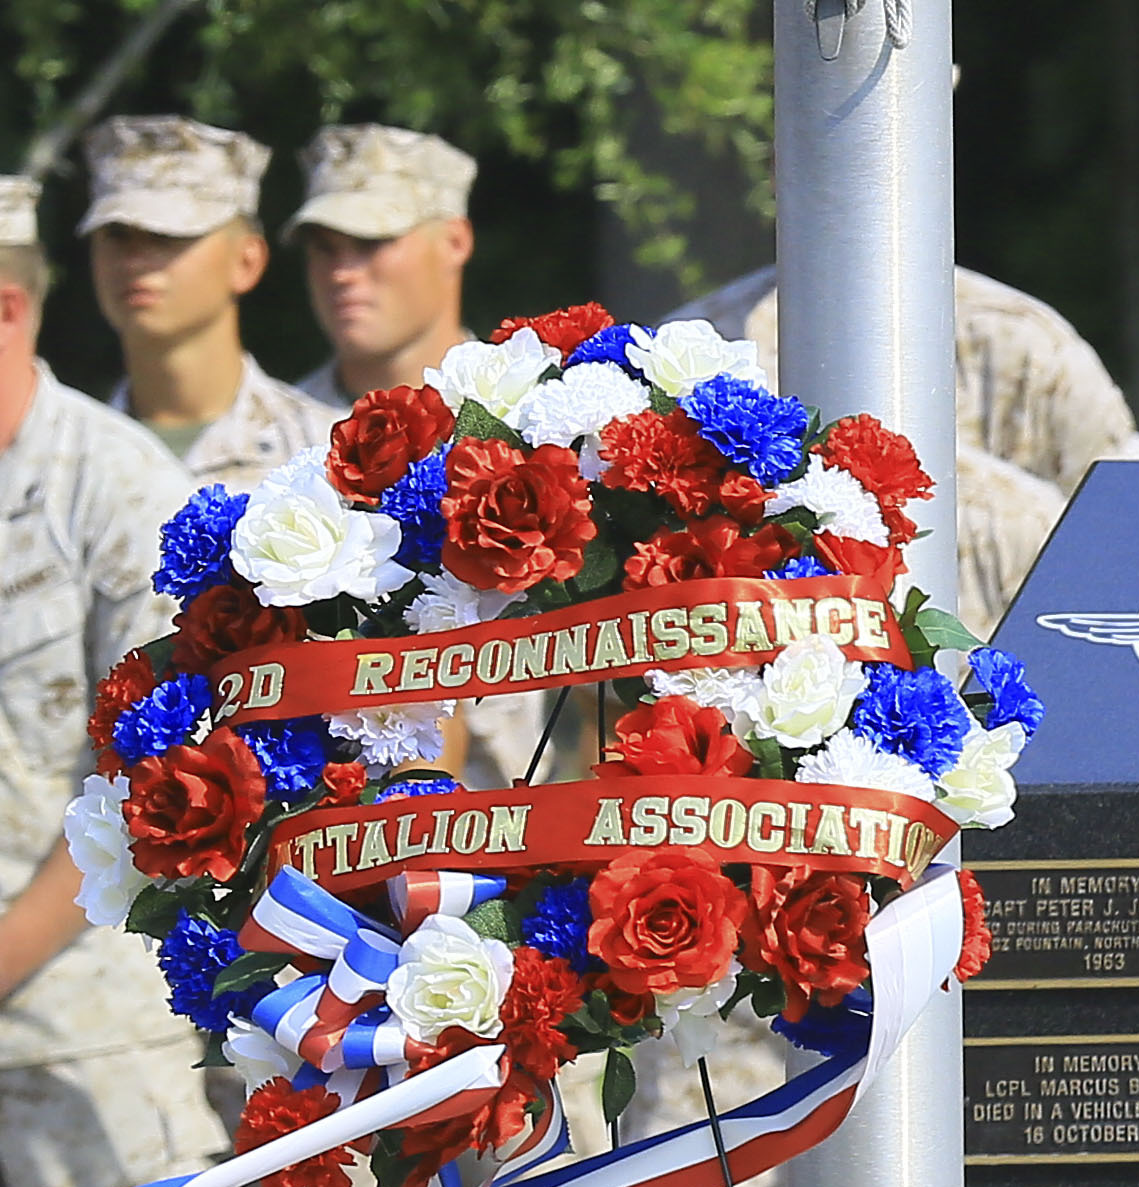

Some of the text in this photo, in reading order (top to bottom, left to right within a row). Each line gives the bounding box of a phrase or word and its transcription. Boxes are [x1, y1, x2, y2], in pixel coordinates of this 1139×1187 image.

[214, 597, 890, 723] 2D RECONNAISSANCE
[1032, 877, 1050, 894] IN
[1036, 898, 1093, 917] PETER
[1103, 898, 1119, 915] J.
[1035, 1055, 1053, 1072] IN
[985, 1080, 1030, 1097] LCPL
[1041, 1077, 1119, 1096] MARCUS
[974, 1102, 1014, 1121] DIED
[1025, 1102, 1042, 1119] IN
[1051, 1102, 1062, 1119] A
[1024, 1126, 1043, 1143] 16
[1053, 1124, 1139, 1143] OCTOBER
